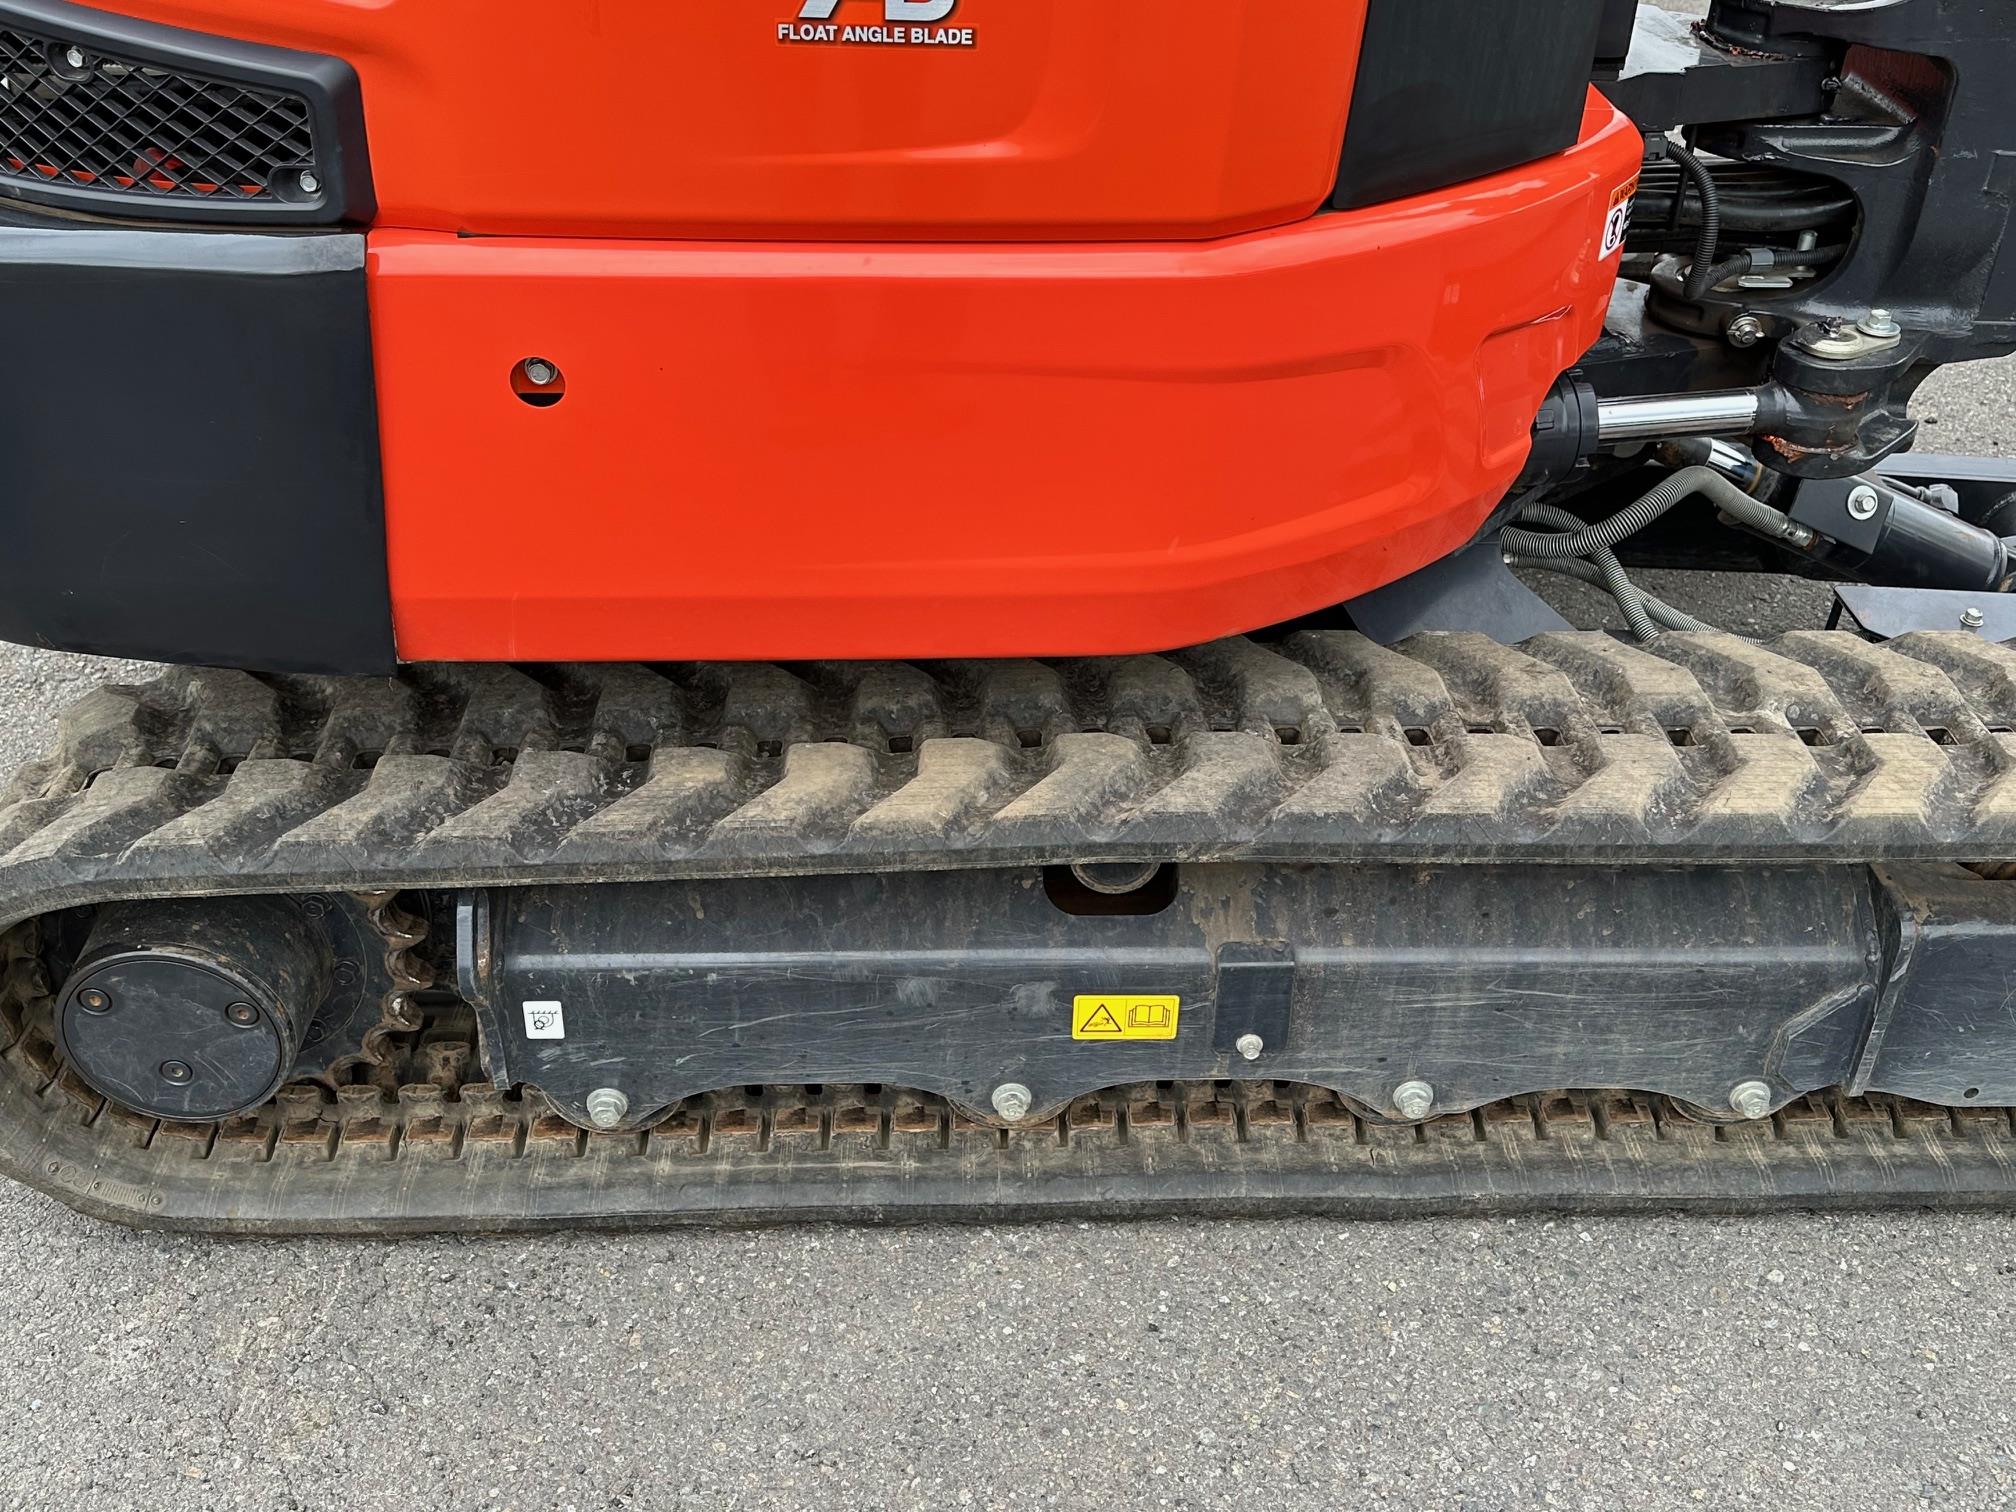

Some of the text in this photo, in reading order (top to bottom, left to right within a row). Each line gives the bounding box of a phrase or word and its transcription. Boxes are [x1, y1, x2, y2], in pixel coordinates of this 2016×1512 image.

[777, 24, 973, 45] FLOAT ANGLE BLADE
